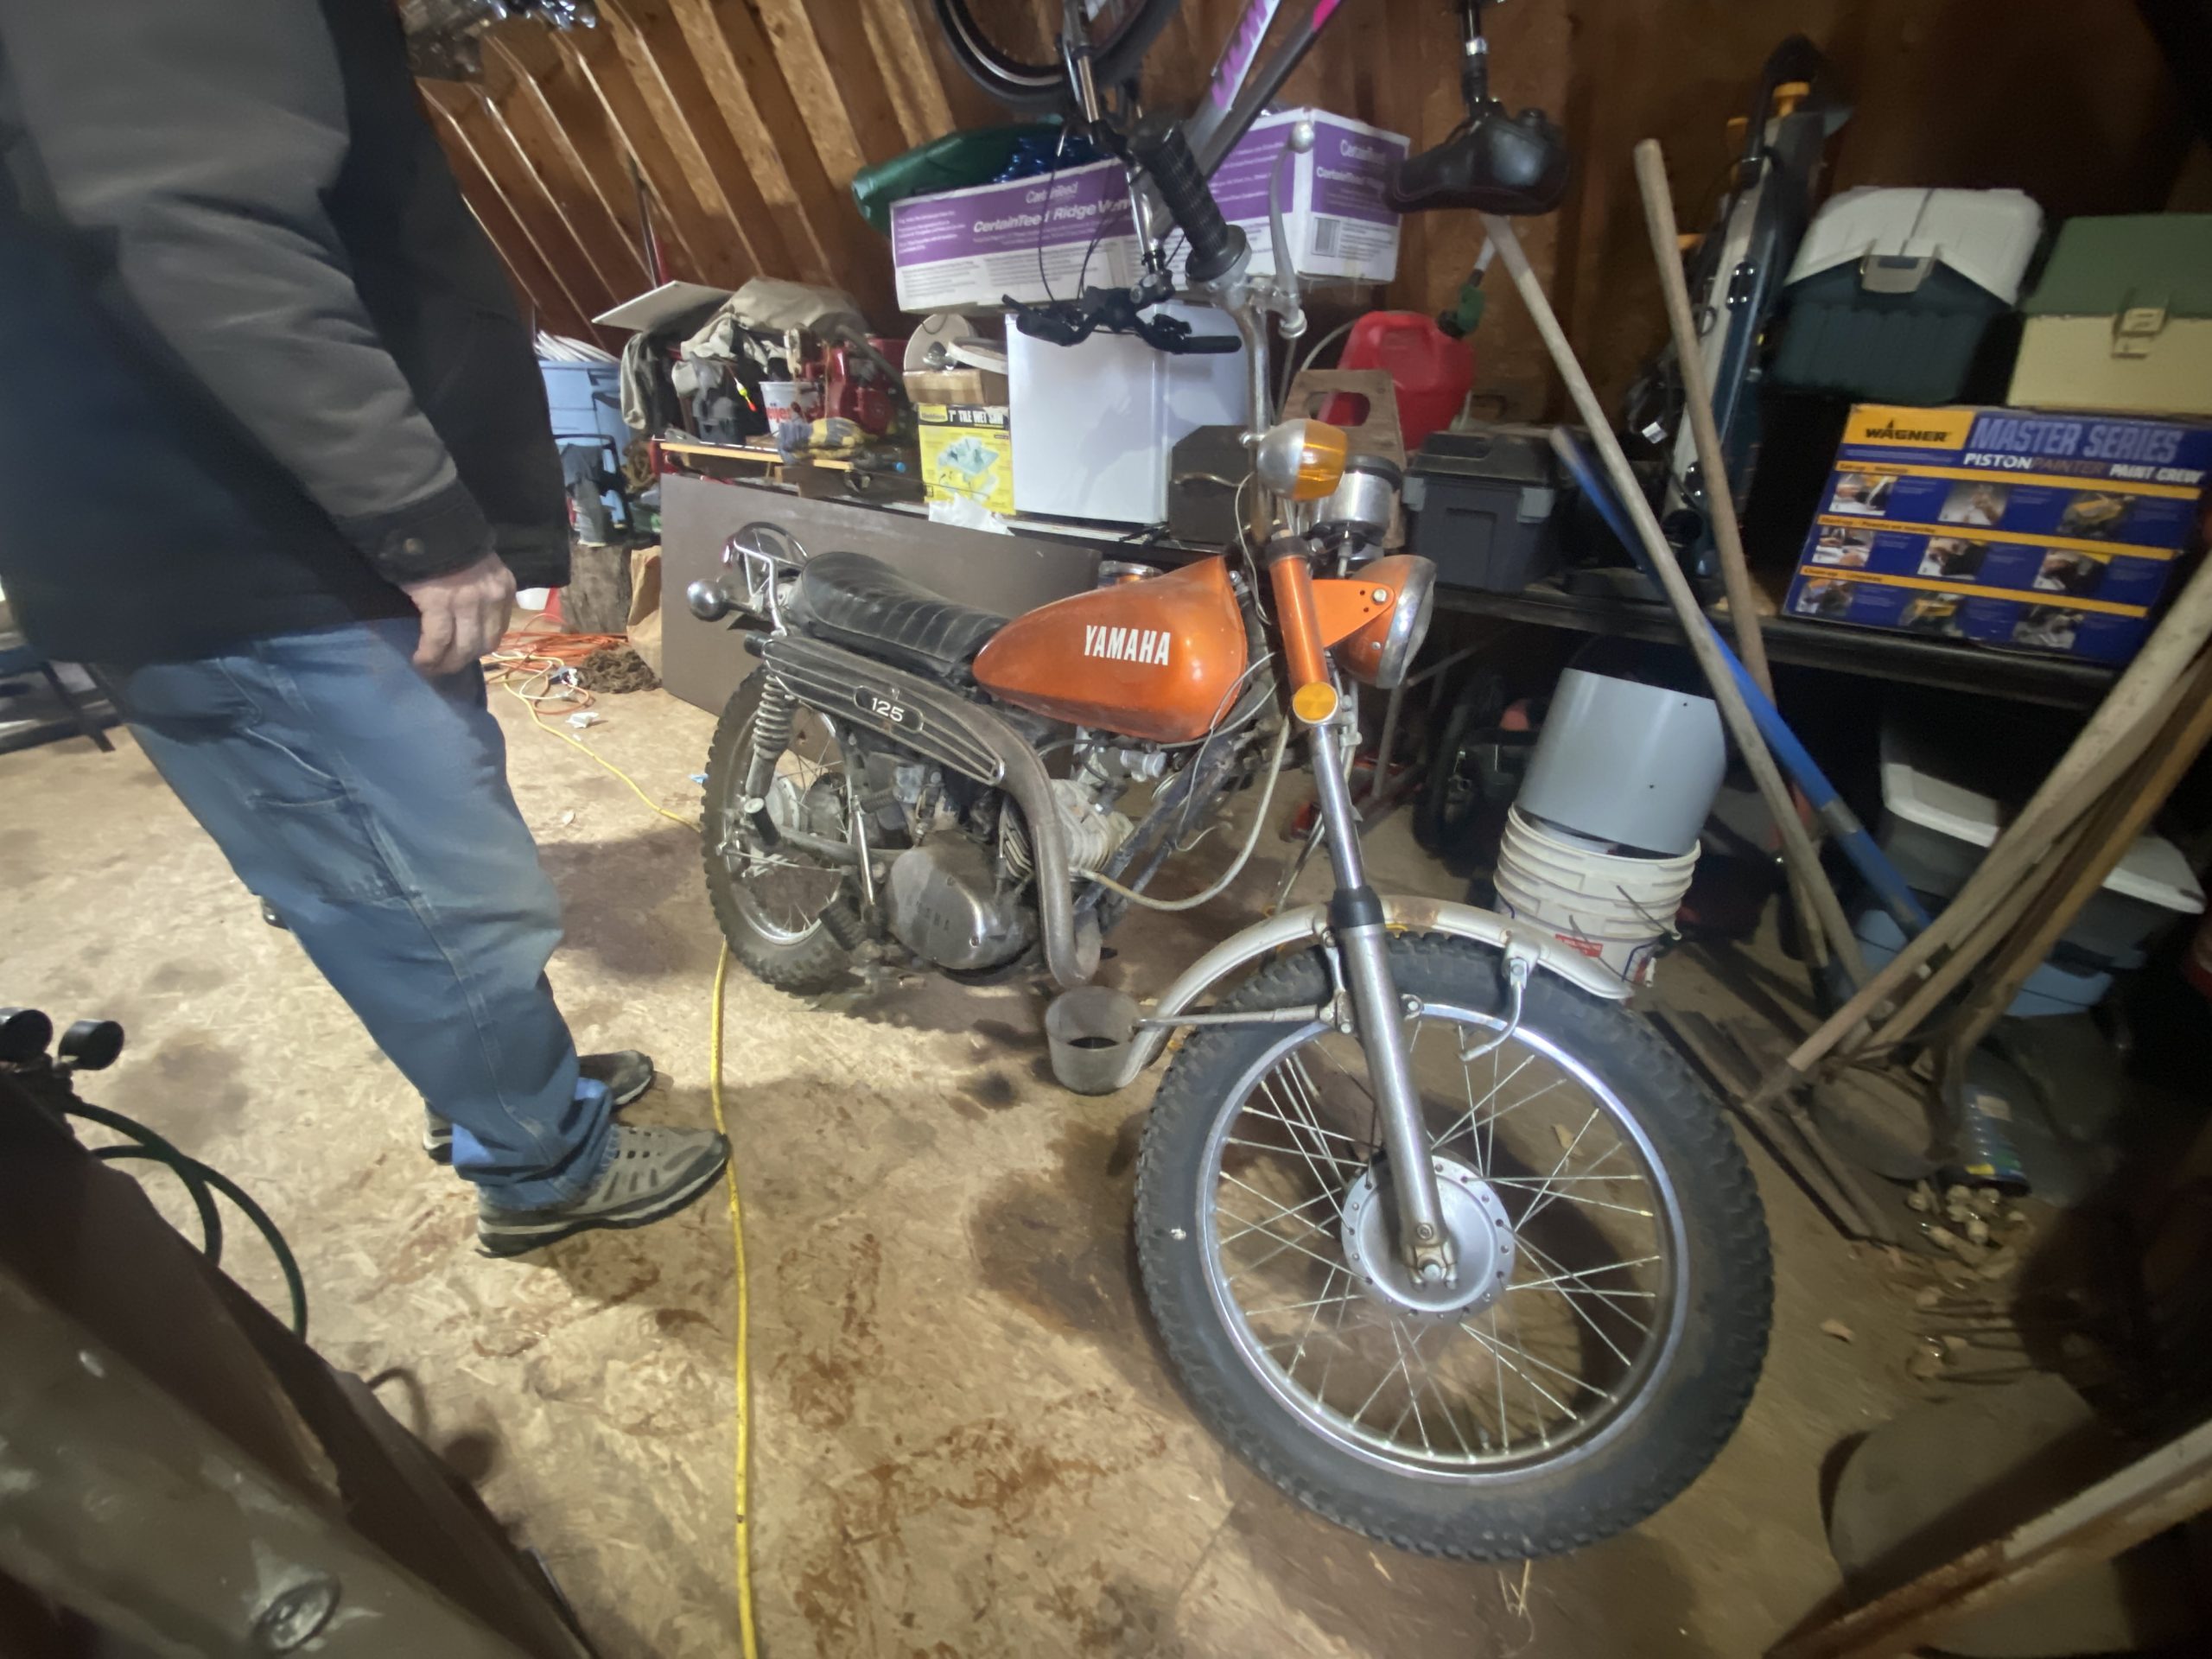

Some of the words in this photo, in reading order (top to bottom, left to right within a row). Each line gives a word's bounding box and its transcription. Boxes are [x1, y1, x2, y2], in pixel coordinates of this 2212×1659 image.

[1026, 181, 1078, 204] CertinTeed
[1053, 203, 1097, 220] Ridge
[957, 410, 972, 423] TILE
[1865, 426, 1948, 442] WAGNER
[1969, 417, 2083, 456] MASTER
[2082, 424, 2184, 464] SERIES
[1962, 453, 2032, 469] PISTON
[2109, 463, 2156, 480] PAINT
[1084, 625, 1171, 666] YAMAHA
[871, 697, 906, 722] 125
